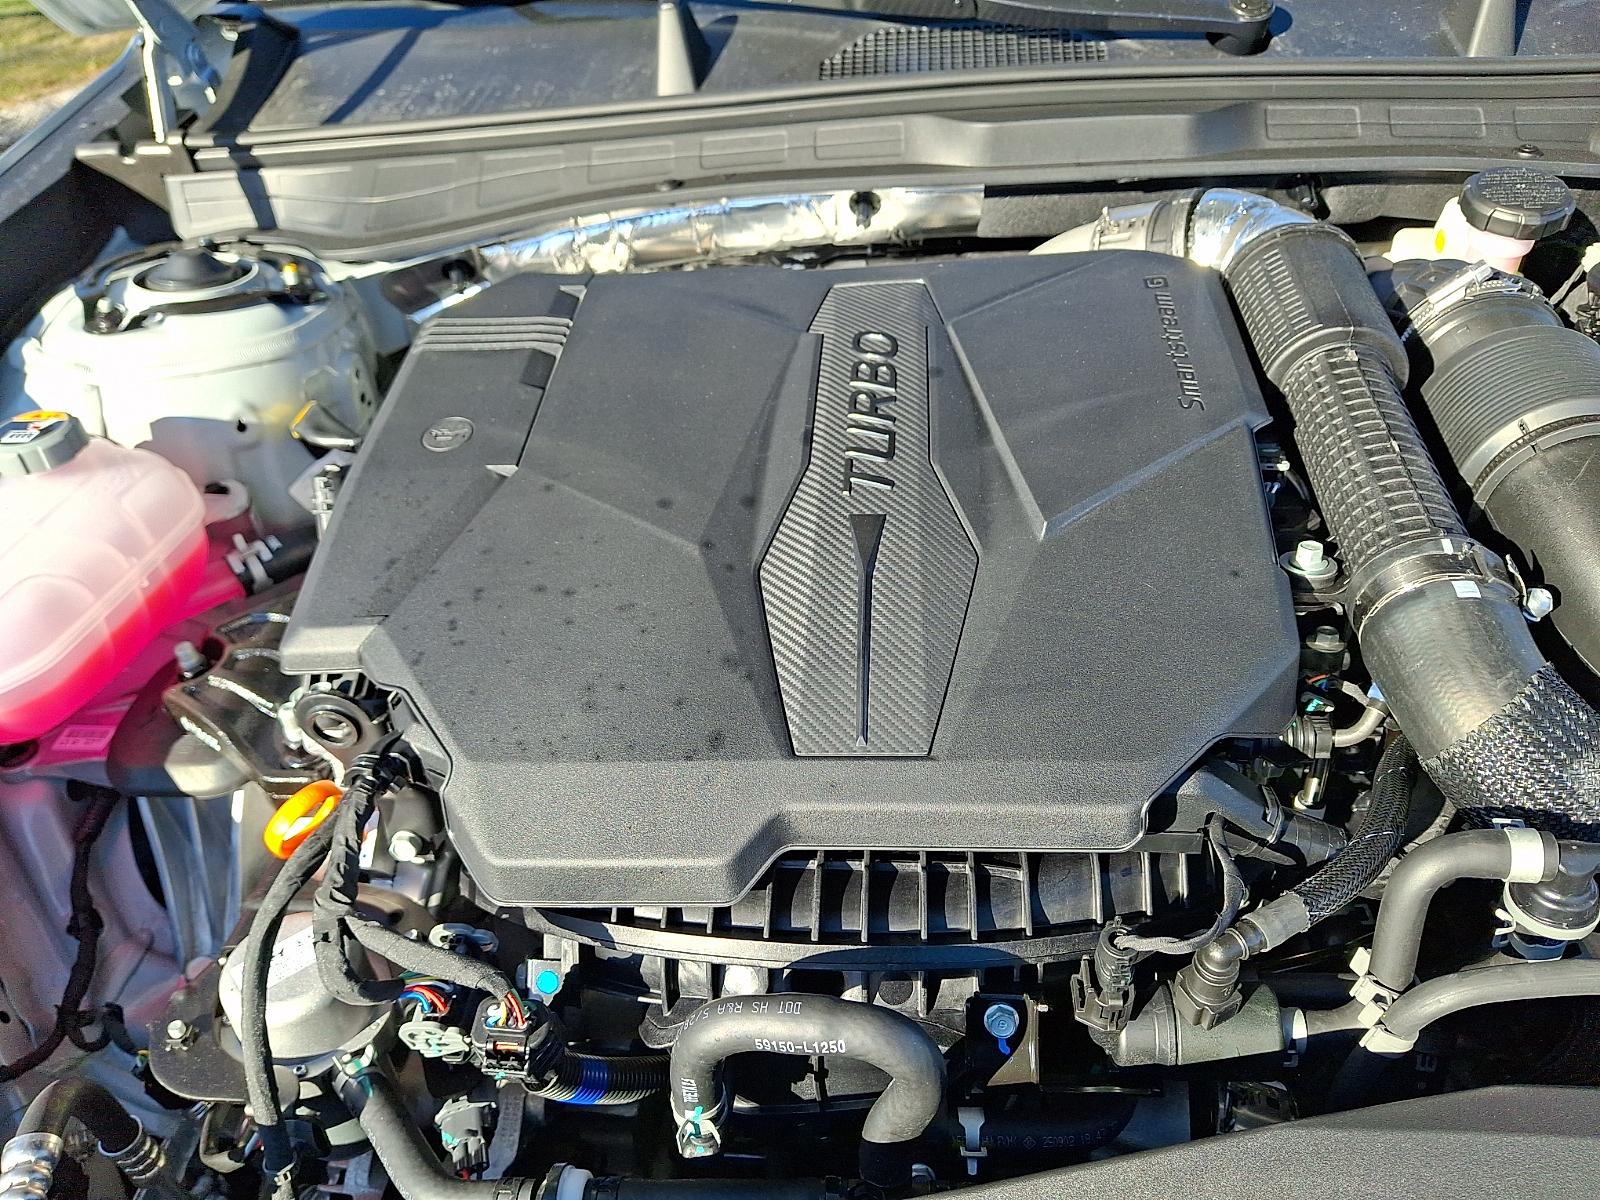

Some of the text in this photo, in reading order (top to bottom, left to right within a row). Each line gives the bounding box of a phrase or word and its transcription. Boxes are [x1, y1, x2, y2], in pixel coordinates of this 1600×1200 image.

[1154, 291, 1205, 411] Smartstream
[842, 331, 899, 496] TURBO
[751, 1001, 769, 1014] HS
[777, 1001, 803, 1015] DOT
[754, 1038, 847, 1054] 59150-L1250
